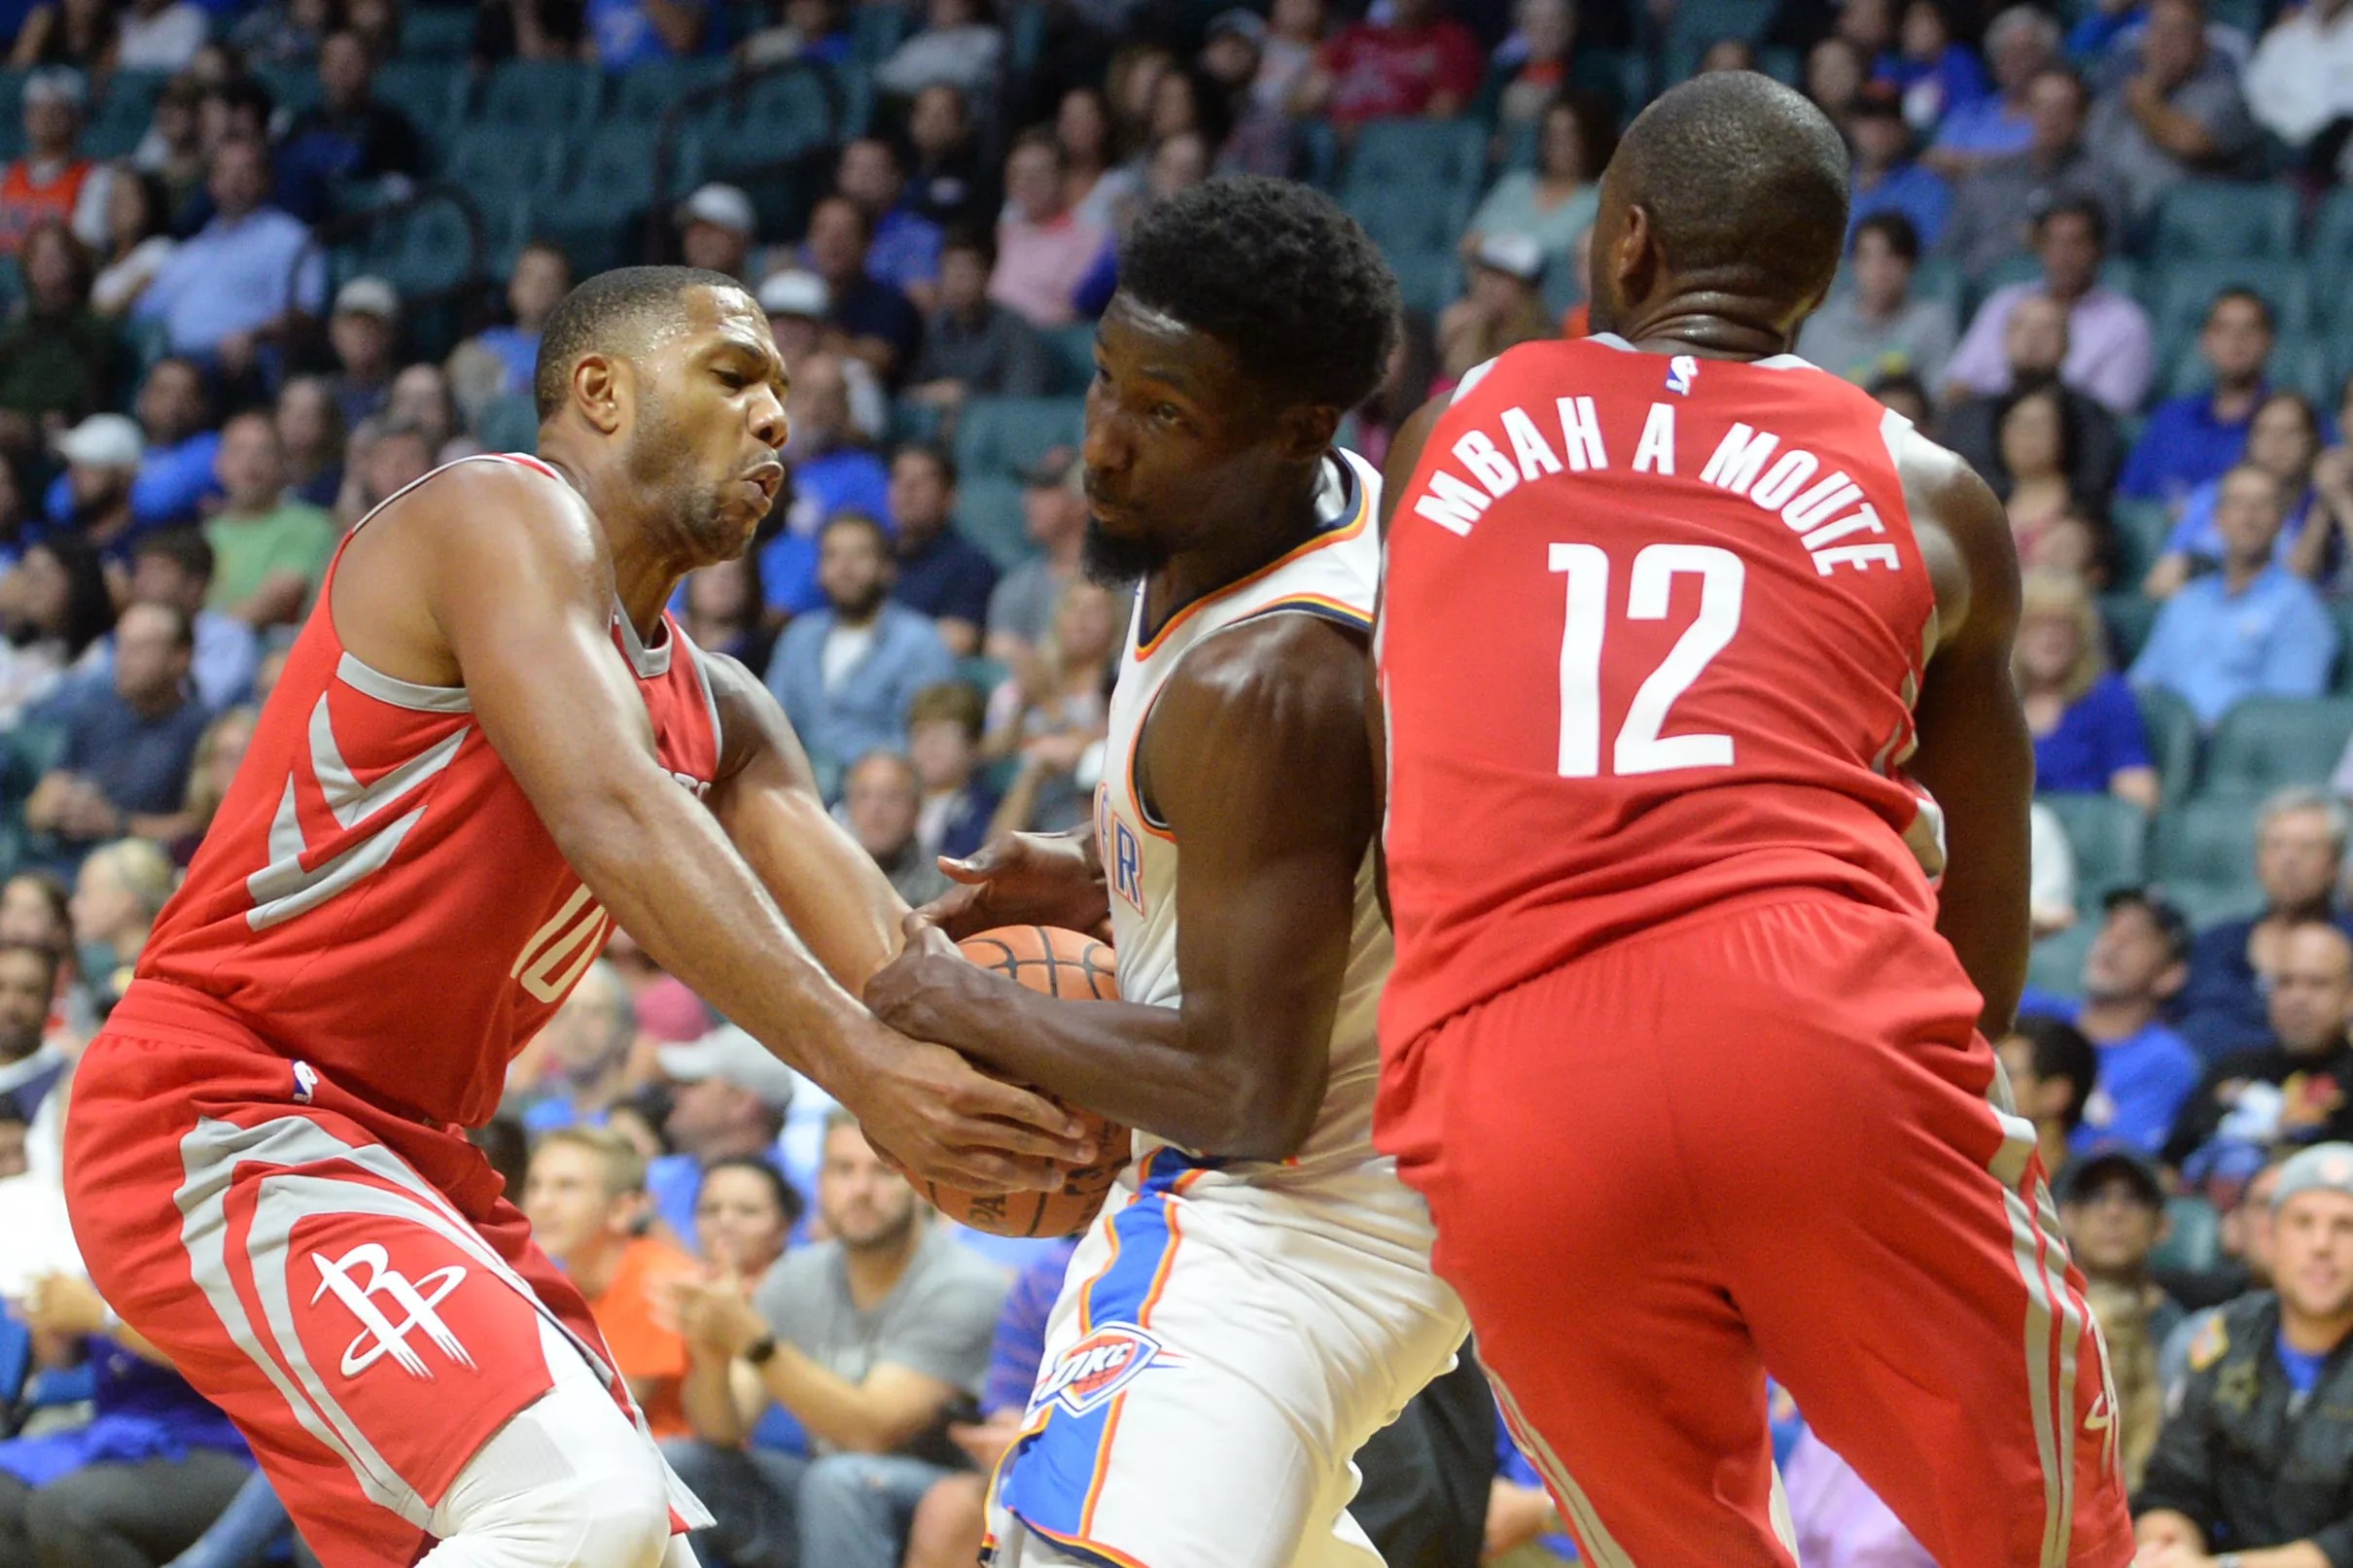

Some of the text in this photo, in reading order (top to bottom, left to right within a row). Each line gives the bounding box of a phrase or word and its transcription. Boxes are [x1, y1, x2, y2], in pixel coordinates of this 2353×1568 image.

[1414, 395, 1901, 577] MBAH A MOUTE
[1547, 541, 1746, 778] 12
